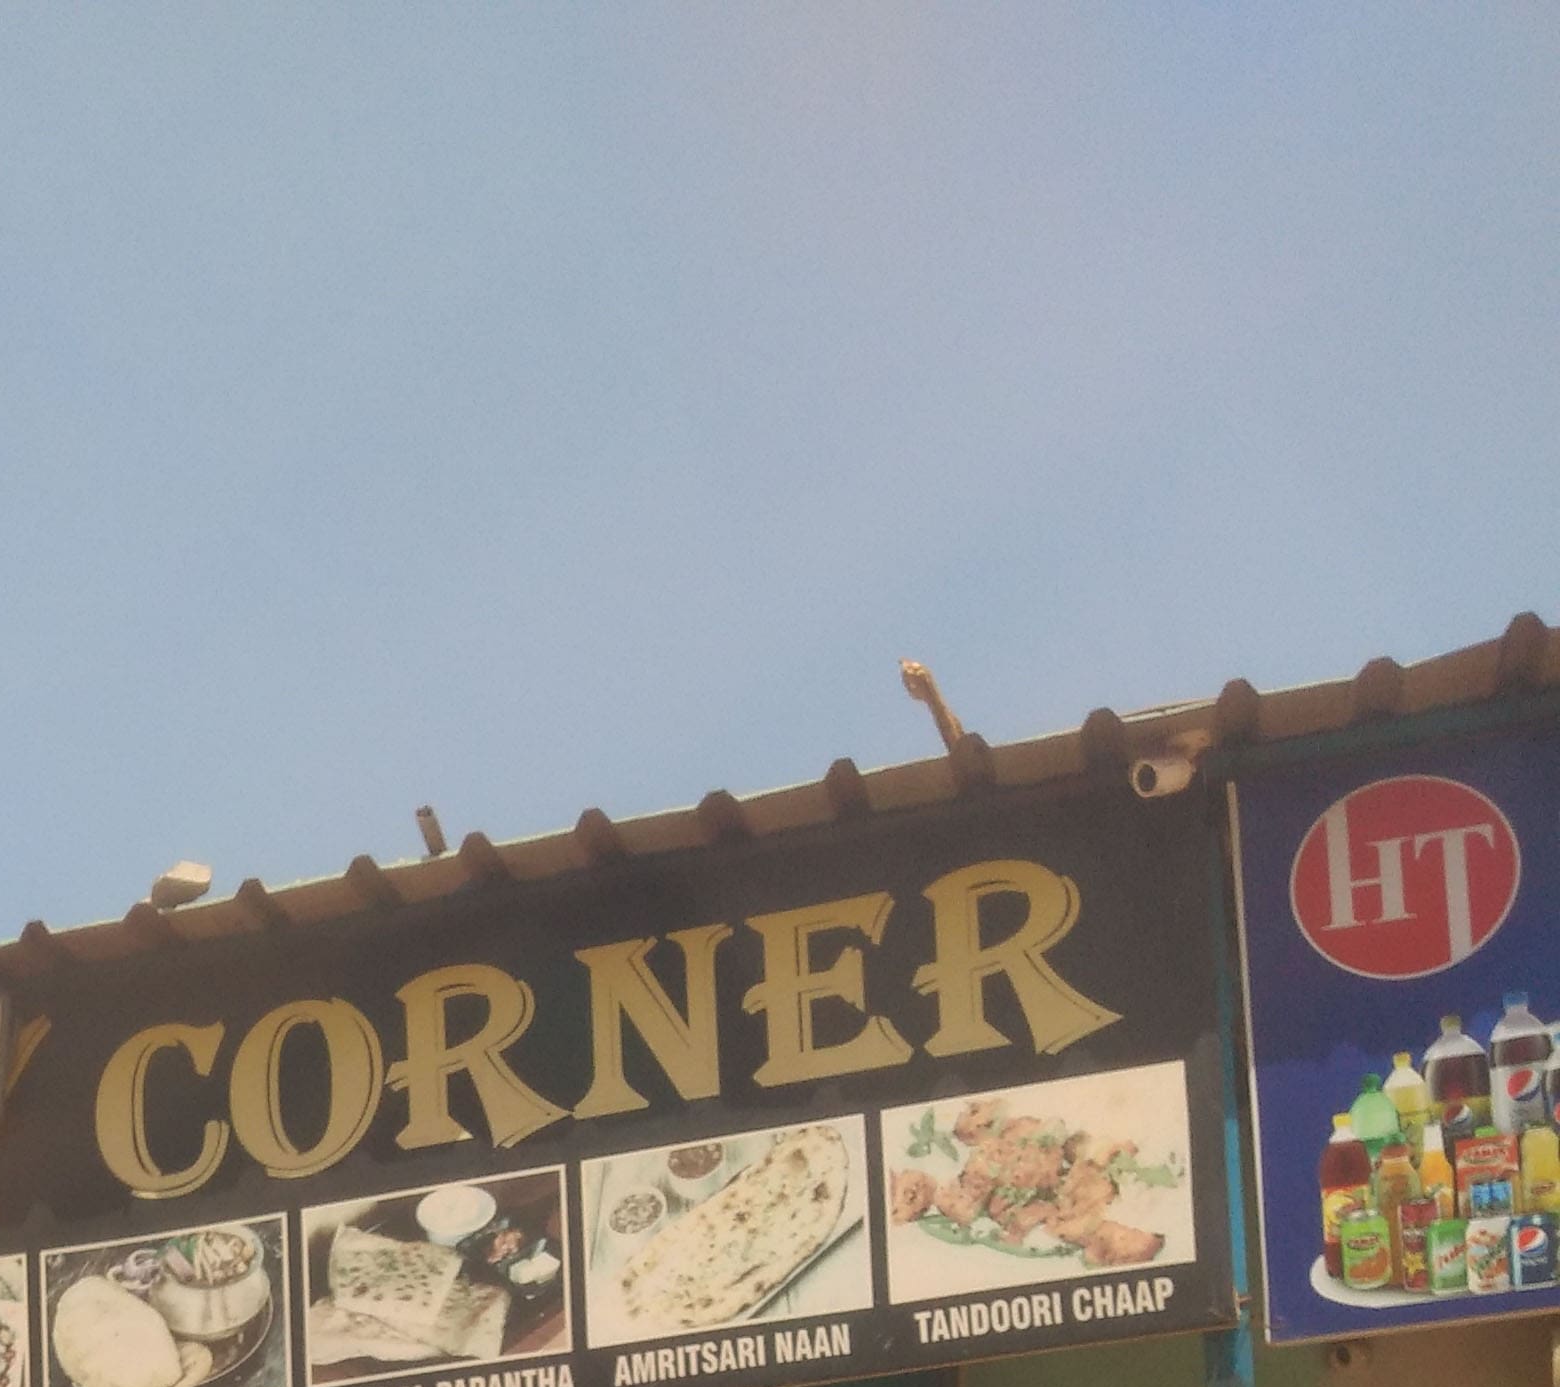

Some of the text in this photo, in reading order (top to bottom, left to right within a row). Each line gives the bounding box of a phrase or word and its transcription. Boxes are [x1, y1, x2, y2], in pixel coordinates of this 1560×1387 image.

[1320, 799, 1496, 963] HT
[95, 858, 1124, 1202] CORNER
[613, 1323, 852, 1387] AMRITSARI NAAN
[913, 1277, 1174, 1344] TANDOORI CHAAP
